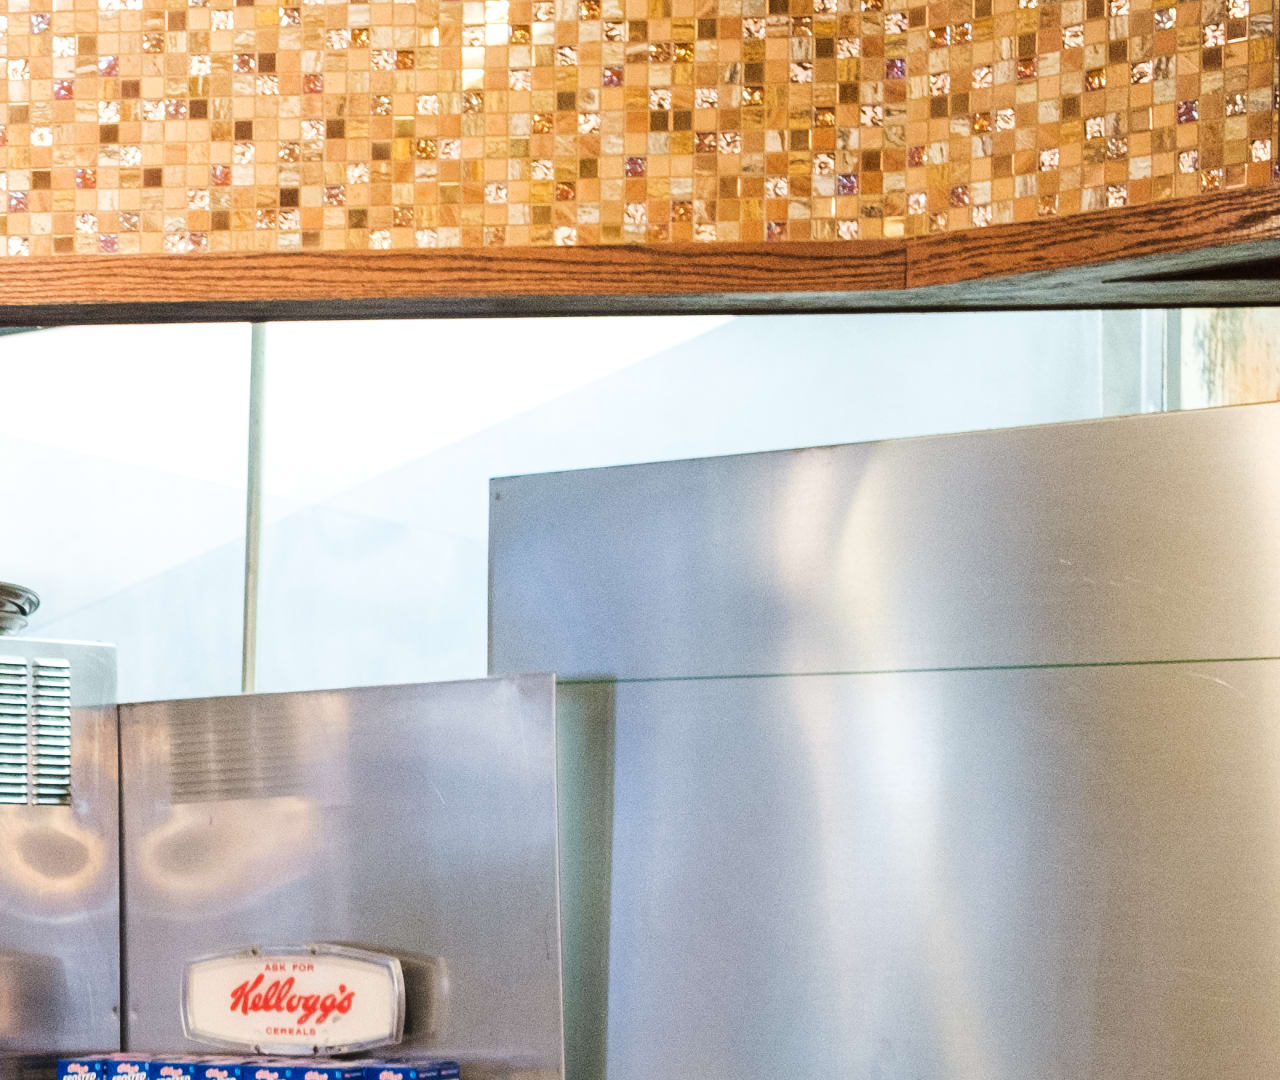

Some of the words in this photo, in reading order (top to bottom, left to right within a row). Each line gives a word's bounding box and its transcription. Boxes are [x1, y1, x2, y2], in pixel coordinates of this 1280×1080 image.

[265, 964, 286, 972] ASK
[292, 964, 314, 972] FOR
[229, 973, 356, 1024] Kellogg's
[265, 1027, 316, 1036] CEREALS
